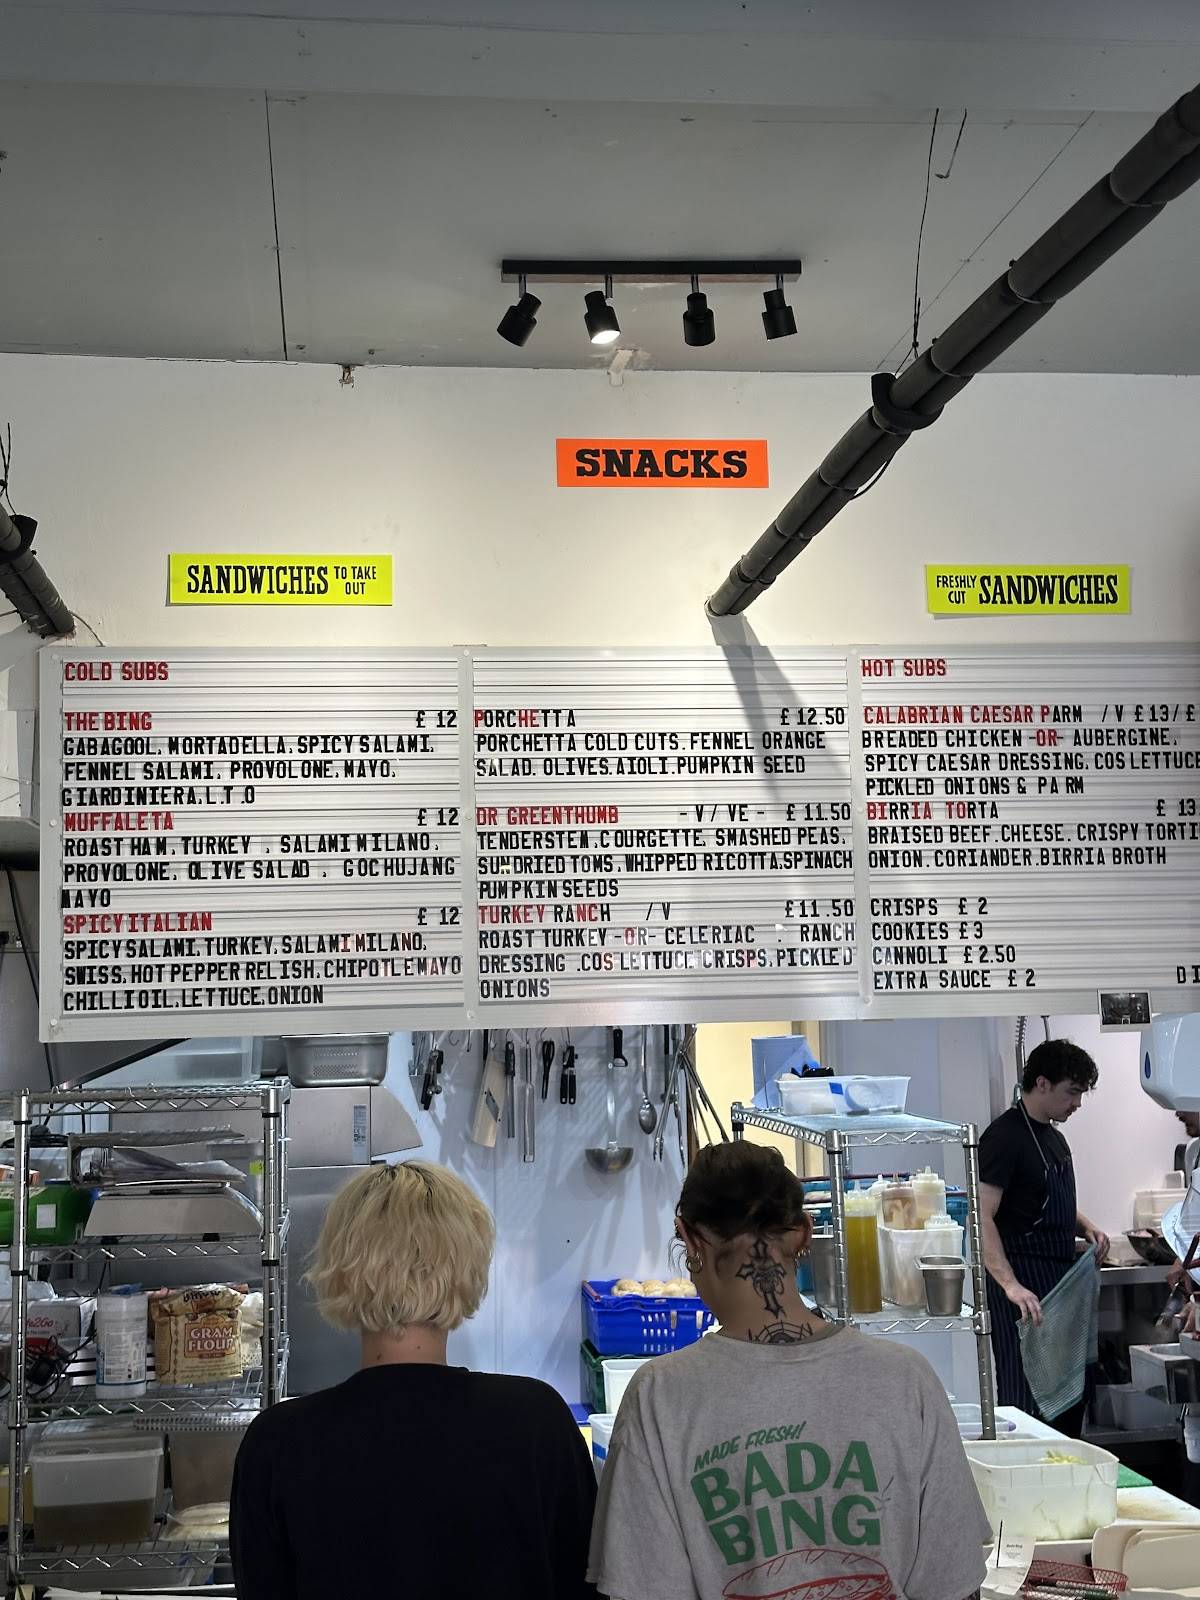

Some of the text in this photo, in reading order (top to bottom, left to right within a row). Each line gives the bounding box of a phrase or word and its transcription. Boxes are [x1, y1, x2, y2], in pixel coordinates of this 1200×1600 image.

[576, 449, 747, 478] SNACKS
[187, 565, 329, 594] SANDWICHES
[334, 566, 376, 579] TO TAKE
[937, 576, 977, 588] FRESHLY
[345, 582, 365, 594] OUT
[948, 591, 966, 604] CUT
[979, 575, 1118, 604] SANDWICHES
[65, 663, 169, 681] COLD SUBS
[862, 659, 946, 677] HOT SUBS
[65, 712, 99, 731] THE
[104, 712, 152, 730] BING
[436, 710, 457, 728] 12
[474, 710, 576, 728] PORCHETTA
[797, 708, 845, 725] 12.50
[864, 706, 963, 724] CALABRIAN
[971, 705, 1033, 723] CAESAR
[1041, 705, 1082, 723] PARM
[298, 736, 354, 754] SPICY
[477, 733, 577, 752] PORCHETTA
[585, 733, 628, 751] COLD
[690, 732, 754, 750] FENNEL
[763, 731, 825, 749] ORANGE
[862, 730, 937, 748] BREADED
[946, 729, 1022, 747] CHICKEN
[65, 762, 135, 781] FENNEL
[677, 756, 754, 774] PUMPKIN
[763, 756, 805, 773] SEED
[865, 754, 918, 772] SPICY
[927, 753, 990, 771] CAESAR
[1094, 752, 1125, 769] COS
[866, 778, 933, 796] PICKLED
[945, 777, 1010, 795] ONIONS
[1017, 776, 1026, 794] &
[65, 812, 174, 831] MUFFALETA
[437, 808, 459, 825] 12
[477, 807, 498, 825] DR
[507, 806, 618, 824] GREENTHUMB
[804, 804, 851, 821] 11.50
[867, 802, 932, 820] BIRRIA
[946, 801, 999, 819] TORTA
[716, 828, 791, 847] SMASHED
[868, 827, 943, 844] BRAISED
[1077, 823, 1138, 841] CRISPY
[65, 837, 124, 856] ROAST
[181, 836, 251, 854] TURKEY
[281, 834, 351, 853] SALAMI
[625, 853, 697, 872] WHIPPED
[783, 851, 852, 870] SPINACH
[1041, 848, 1105, 866] BIRRIA
[1112, 846, 1166, 864] BROTH
[189, 861, 246, 879] OLIVE
[253, 860, 310, 878] SALAD
[344, 858, 455, 877] GOCHUJANG
[61, 889, 111, 908] MAYO
[480, 879, 618, 899] PUMPKIN SEEDS
[479, 905, 544, 924] TURKEY
[554, 903, 611, 922] RANCH
[870, 898, 938, 916] CRISPS
[64, 914, 125, 934] SPICY
[128, 913, 212, 931] ITALIAN
[436, 907, 460, 925] 12
[479, 930, 534, 949] ROAST
[542, 928, 607, 947] TURKEY
[665, 926, 755, 945] CELERIAC
[800, 924, 855, 941] RANCH
[872, 922, 949, 940] COOKIES
[64, 940, 123, 960] SPICY
[282, 935, 351, 954] SALAMI
[873, 946, 947, 965] CANNOLI
[131, 965, 166, 983] HOT
[171, 963, 240, 982] PEPPER
[325, 958, 414, 978] CHIPOTLE
[417, 956, 461, 976] MAYO
[480, 955, 566, 974] DRESSING
[777, 948, 852, 967] PICKLED
[480, 979, 550, 999] ONIONS
[874, 971, 928, 990] EXTRA
[940, 970, 991, 988] SAUCE
[64, 991, 135, 1012] CHILLI
[268, 985, 324, 1005] ONION
[191, 1328, 233, 1338] GRAM
[694, 1421, 807, 1472] MADE FRESH!
[690, 1440, 879, 1521] BADA
[709, 1494, 881, 1565] BING
